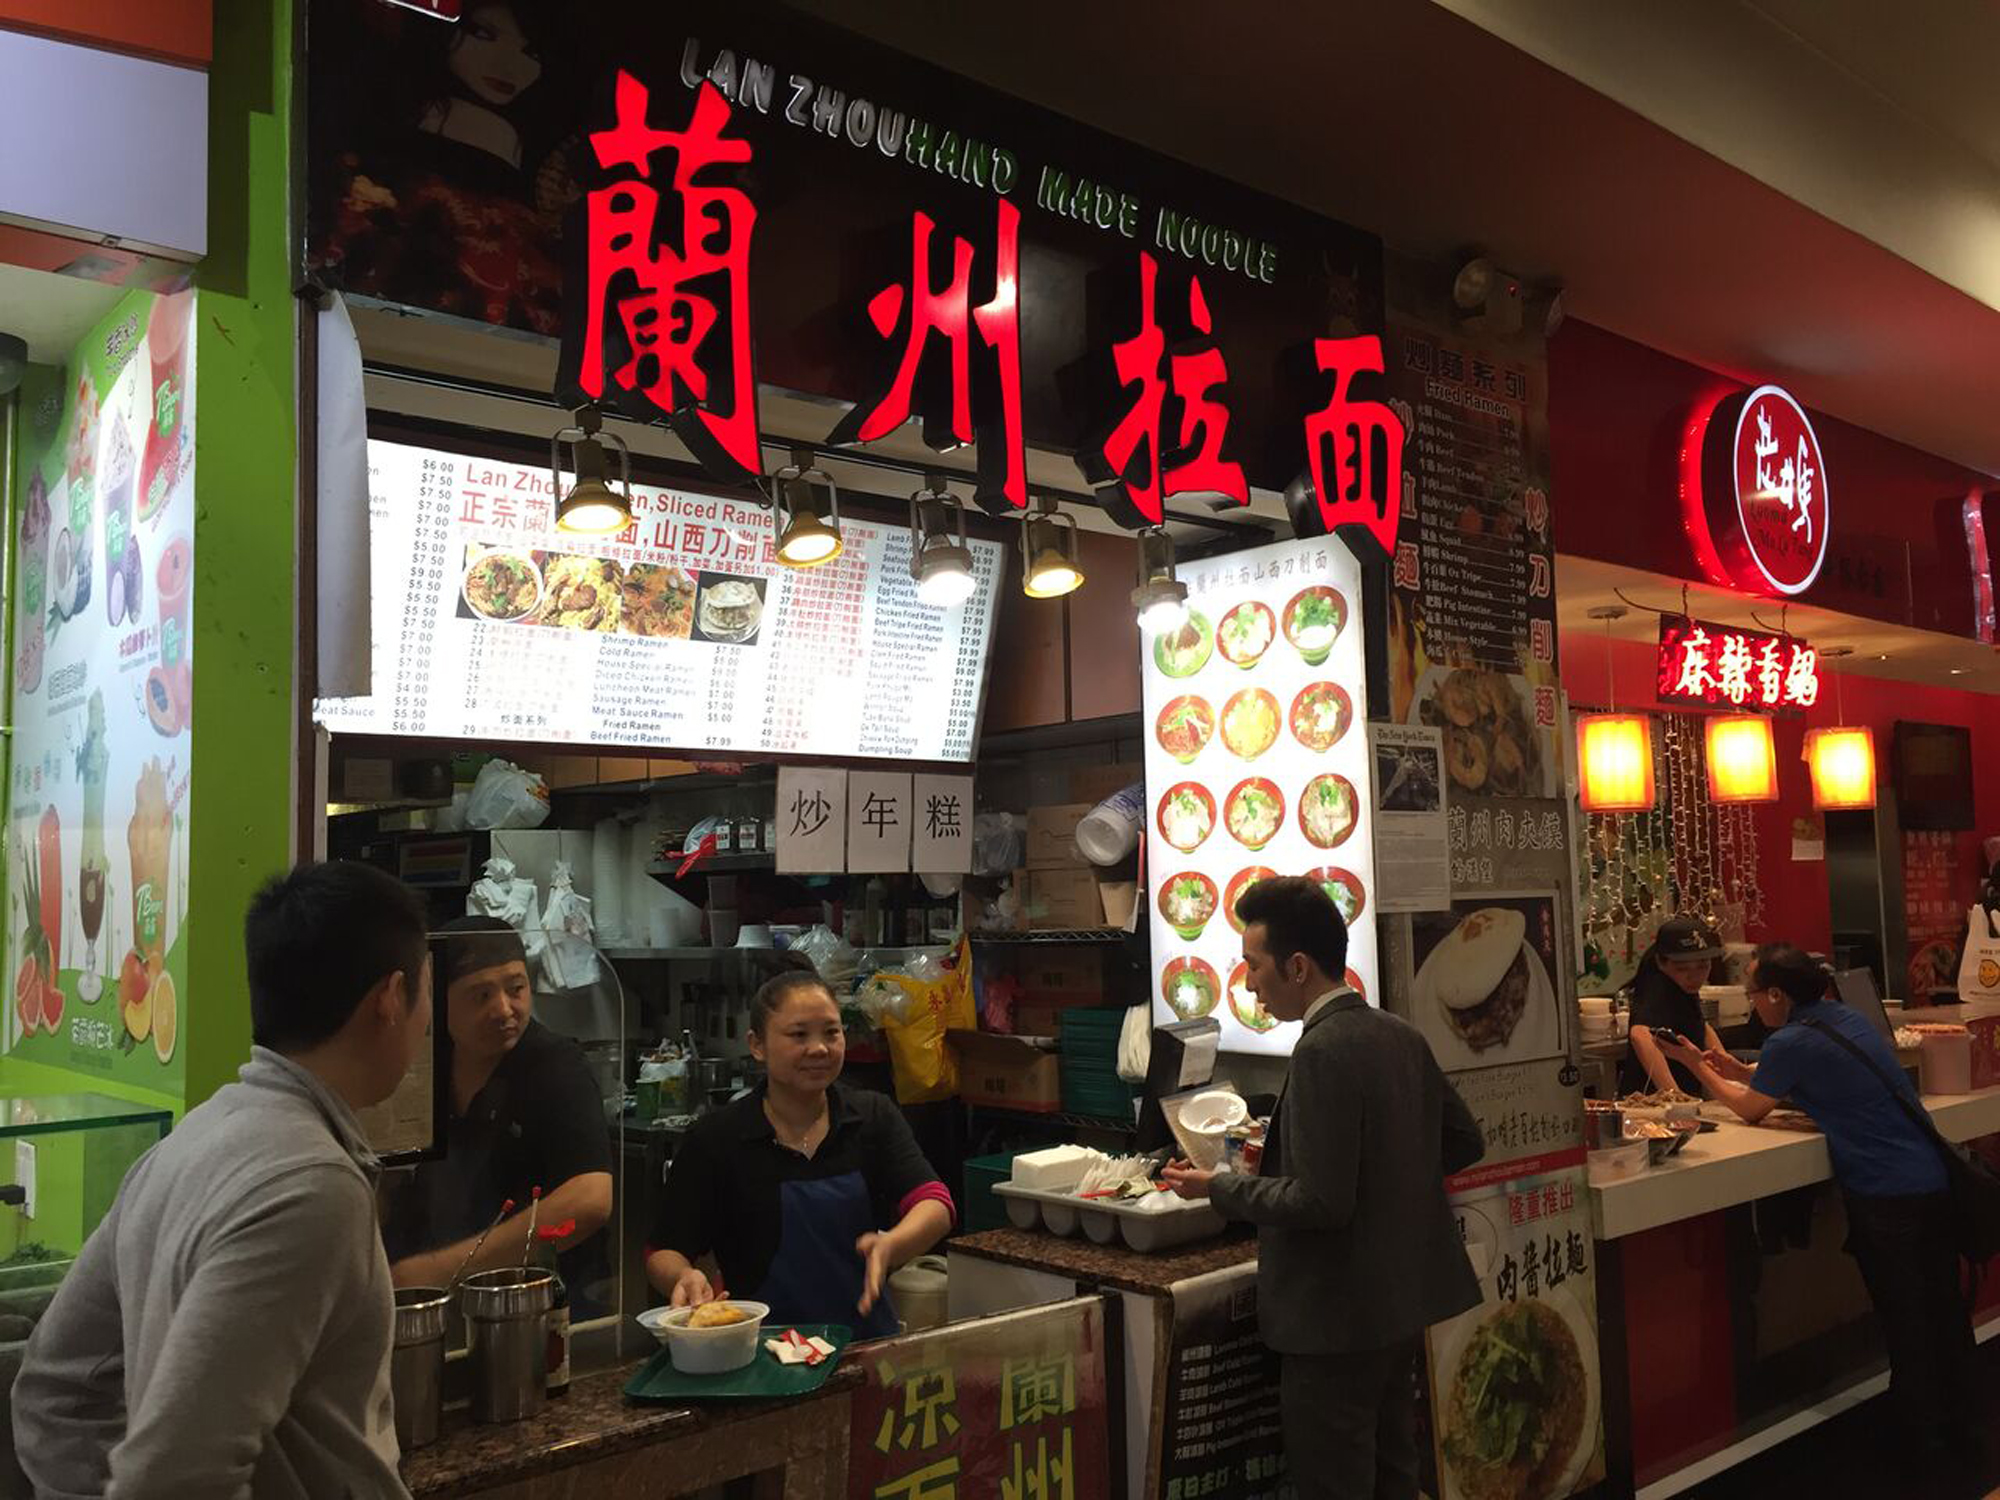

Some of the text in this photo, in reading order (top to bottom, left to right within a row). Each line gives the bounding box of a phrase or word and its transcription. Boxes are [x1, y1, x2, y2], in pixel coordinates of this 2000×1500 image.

[680, 37, 775, 114] LAN
[1037, 165, 1139, 238] MADE
[1156, 207, 1276, 284] NOODLE
[1425, 376, 1511, 421] Fried Ramen
[466, 462, 507, 488] Lan
[790, 789, 961, 839] 炒年糕
[1509, 1177, 1574, 1226] 隆重推出
